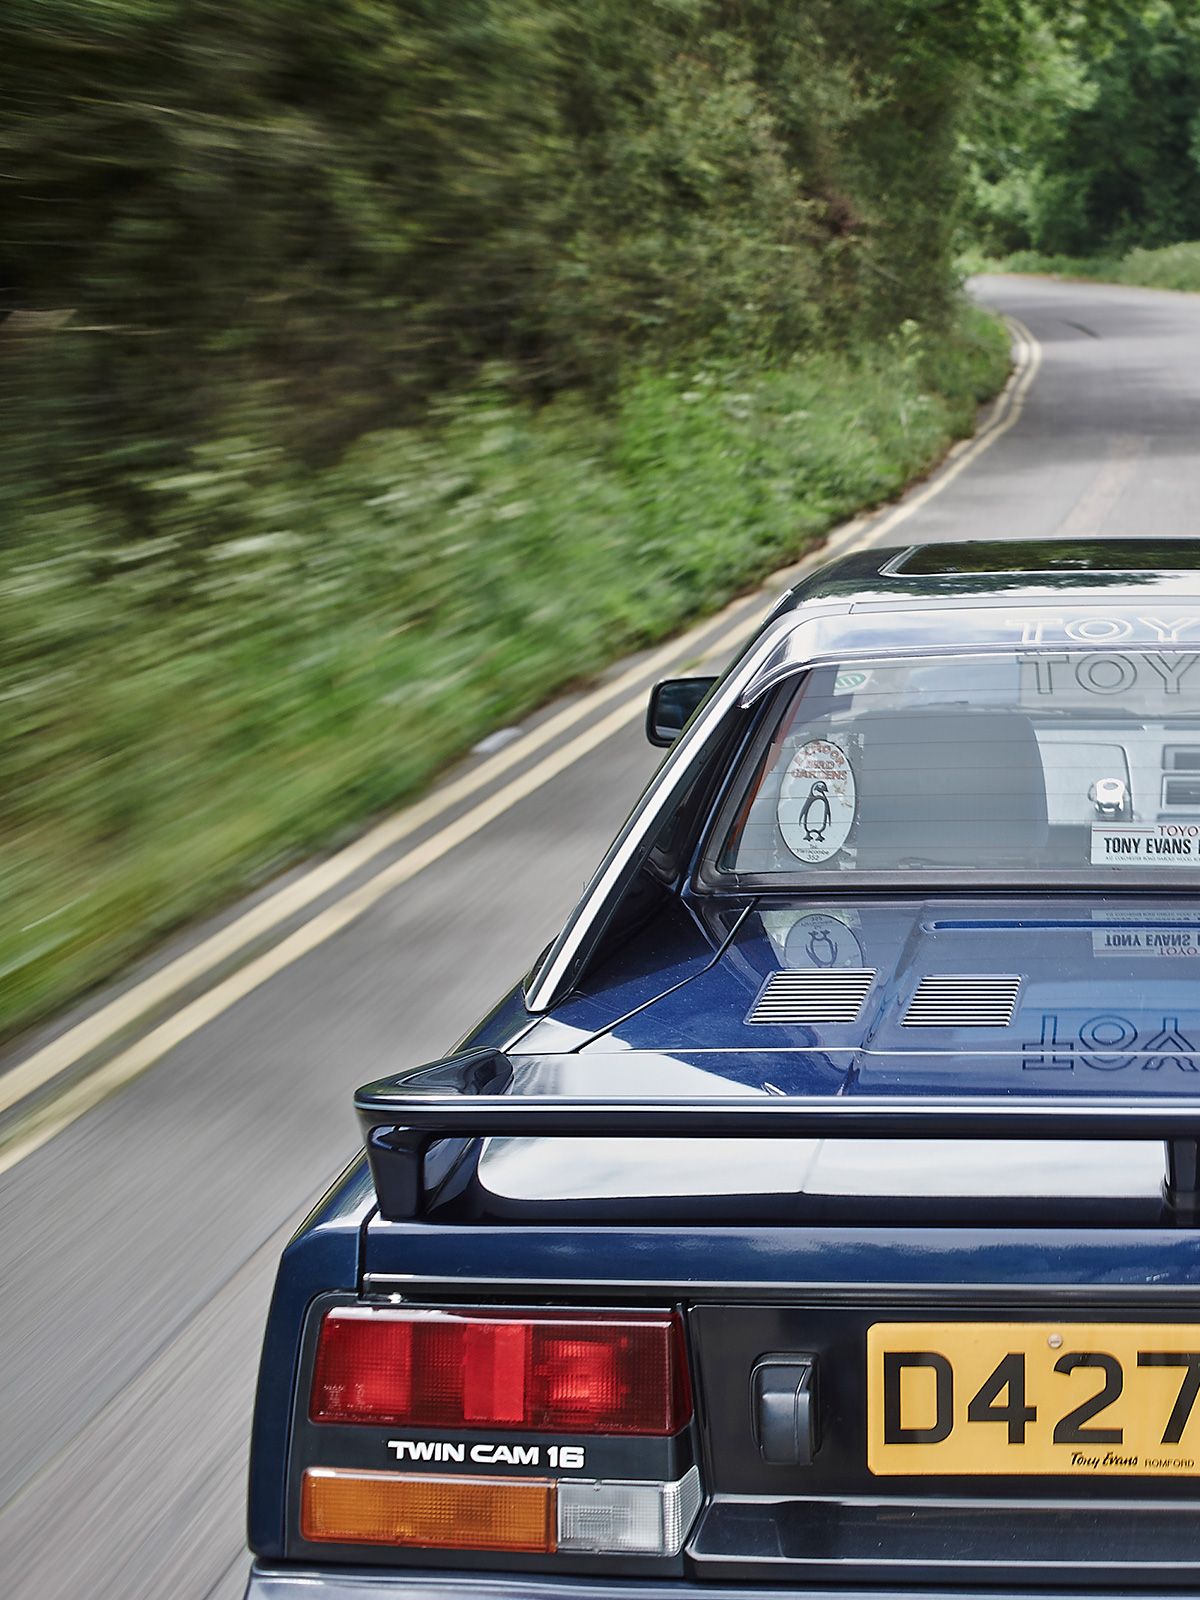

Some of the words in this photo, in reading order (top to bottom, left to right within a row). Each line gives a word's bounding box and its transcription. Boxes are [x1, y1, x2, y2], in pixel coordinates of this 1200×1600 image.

[1104, 837, 1141, 854] TONY
[1146, 838, 1191, 855] EVANS
[387, 1440, 465, 1462] TWIN
[469, 1444, 540, 1466] CAM
[546, 1446, 585, 1469] 16
[1070, 1451, 1100, 1469] Tony
[1103, 1451, 1139, 1467] Evans
[1144, 1458, 1195, 1469] ROMFORD
